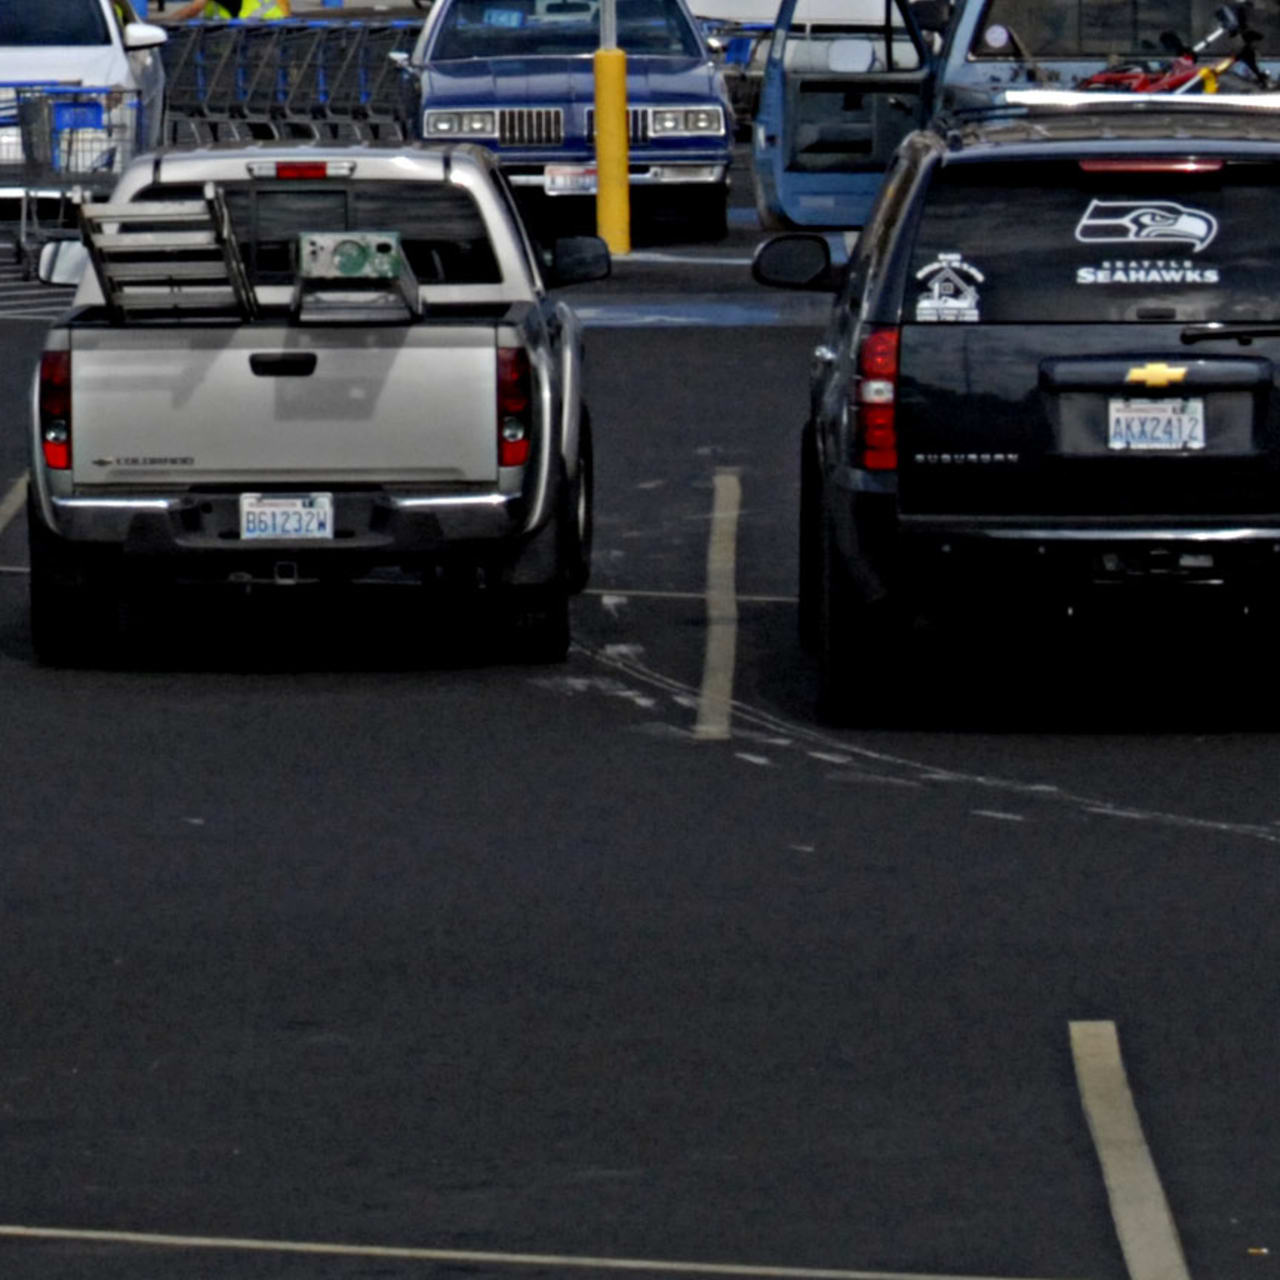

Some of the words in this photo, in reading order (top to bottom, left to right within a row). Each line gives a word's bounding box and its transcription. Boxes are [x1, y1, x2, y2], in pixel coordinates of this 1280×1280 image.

[1101, 260, 1194, 269] SEATTLE
[1076, 267, 1220, 284] SEAHAWKS
[1113, 417, 1200, 441] AKX2412
[245, 510, 328, 534] B61232W
